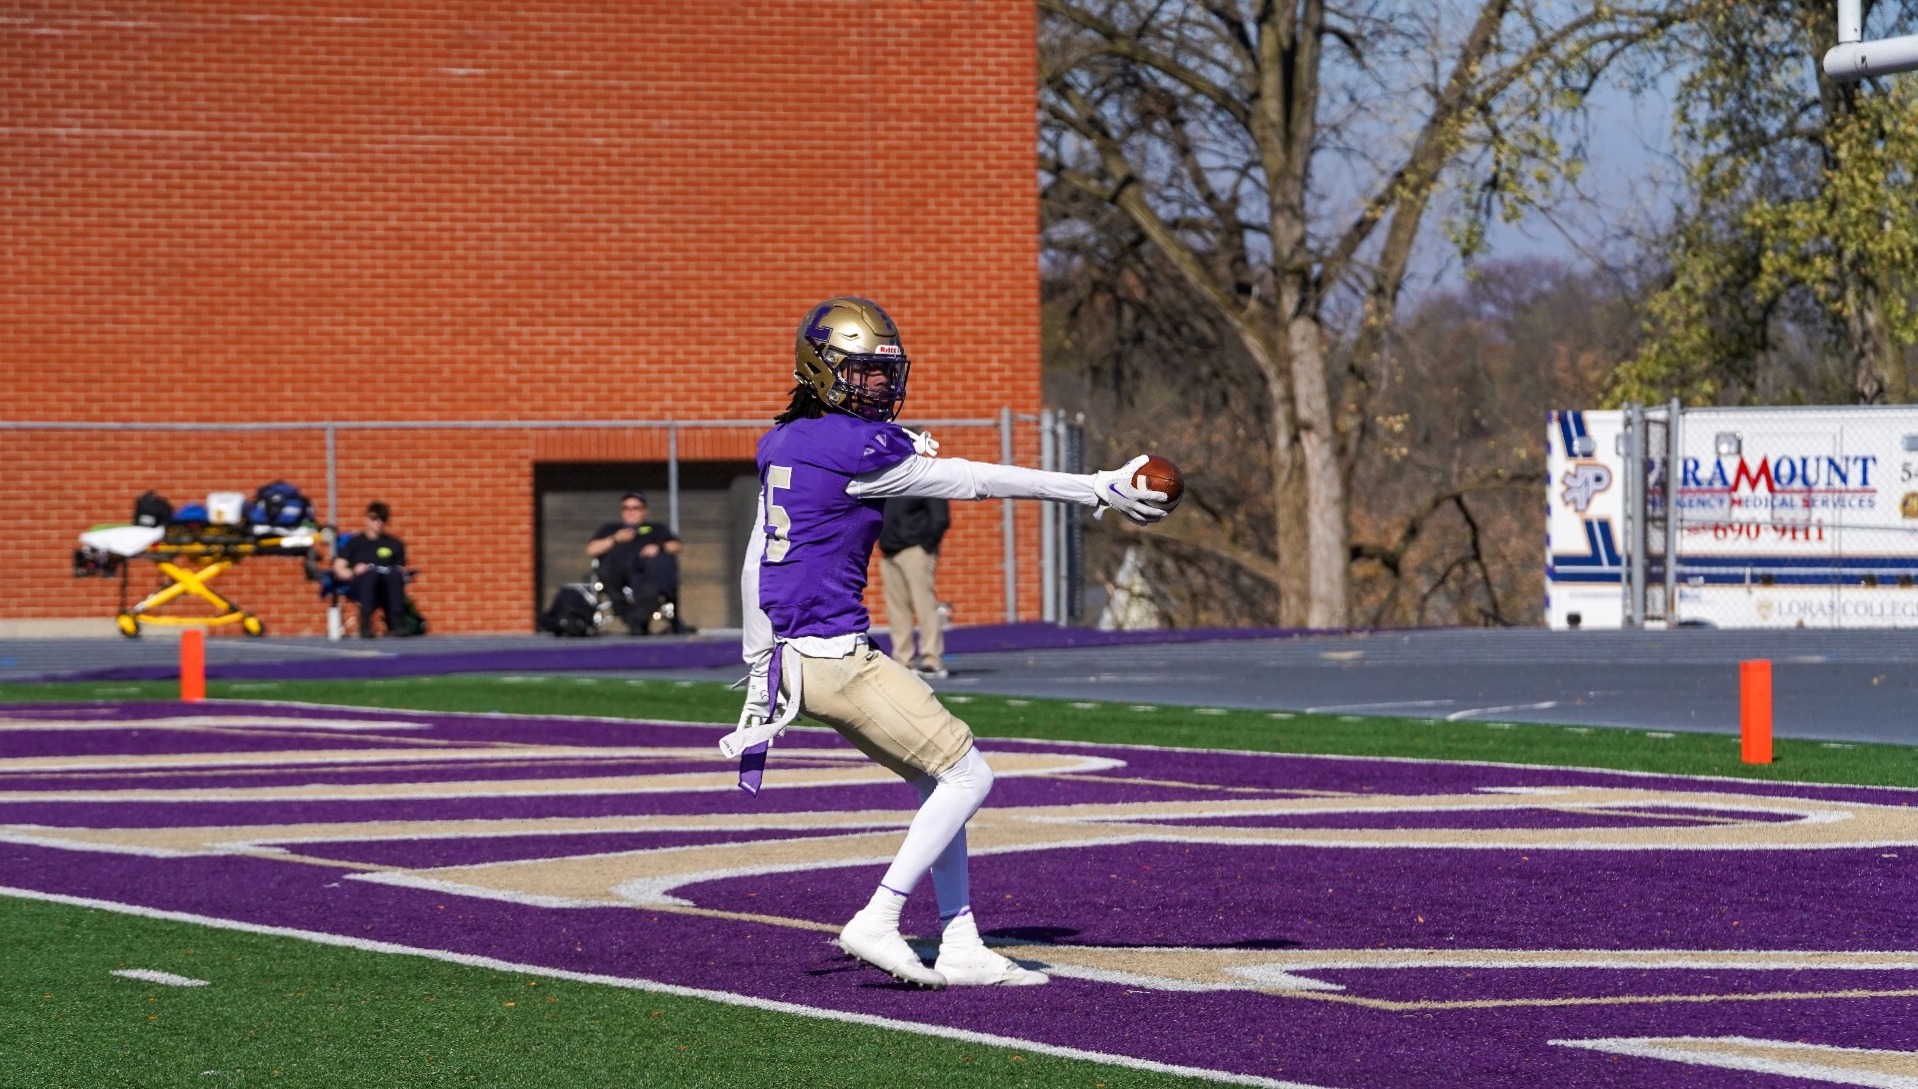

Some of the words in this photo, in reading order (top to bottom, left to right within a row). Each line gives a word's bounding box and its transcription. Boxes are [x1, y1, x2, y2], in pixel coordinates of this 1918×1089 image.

[766, 464, 792, 562] 5
[1730, 496, 1795, 508] MEDICAL
[1803, 496, 1875, 508] SERVICES
